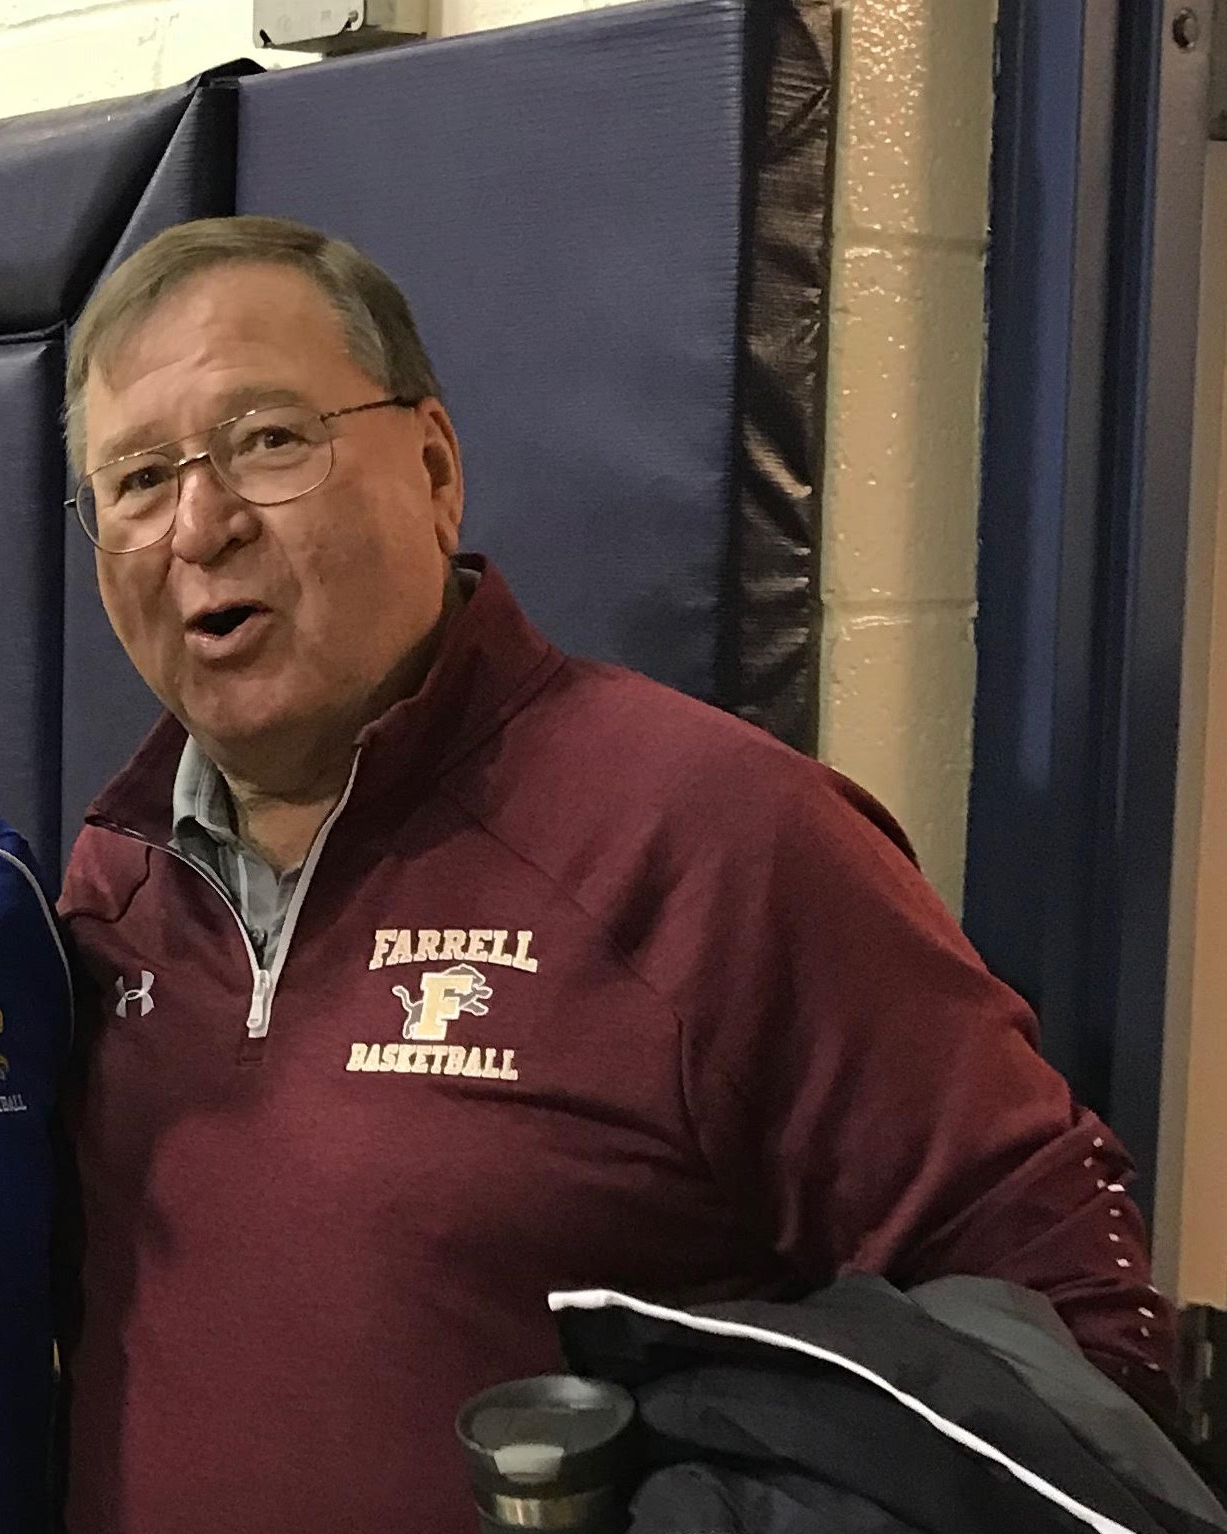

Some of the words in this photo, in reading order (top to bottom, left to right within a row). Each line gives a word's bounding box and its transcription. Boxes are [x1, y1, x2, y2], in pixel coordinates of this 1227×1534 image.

[369, 929, 538, 973] FARRELL
[411, 972, 474, 1041] F
[346, 1043, 519, 1081] BASKETBALL
